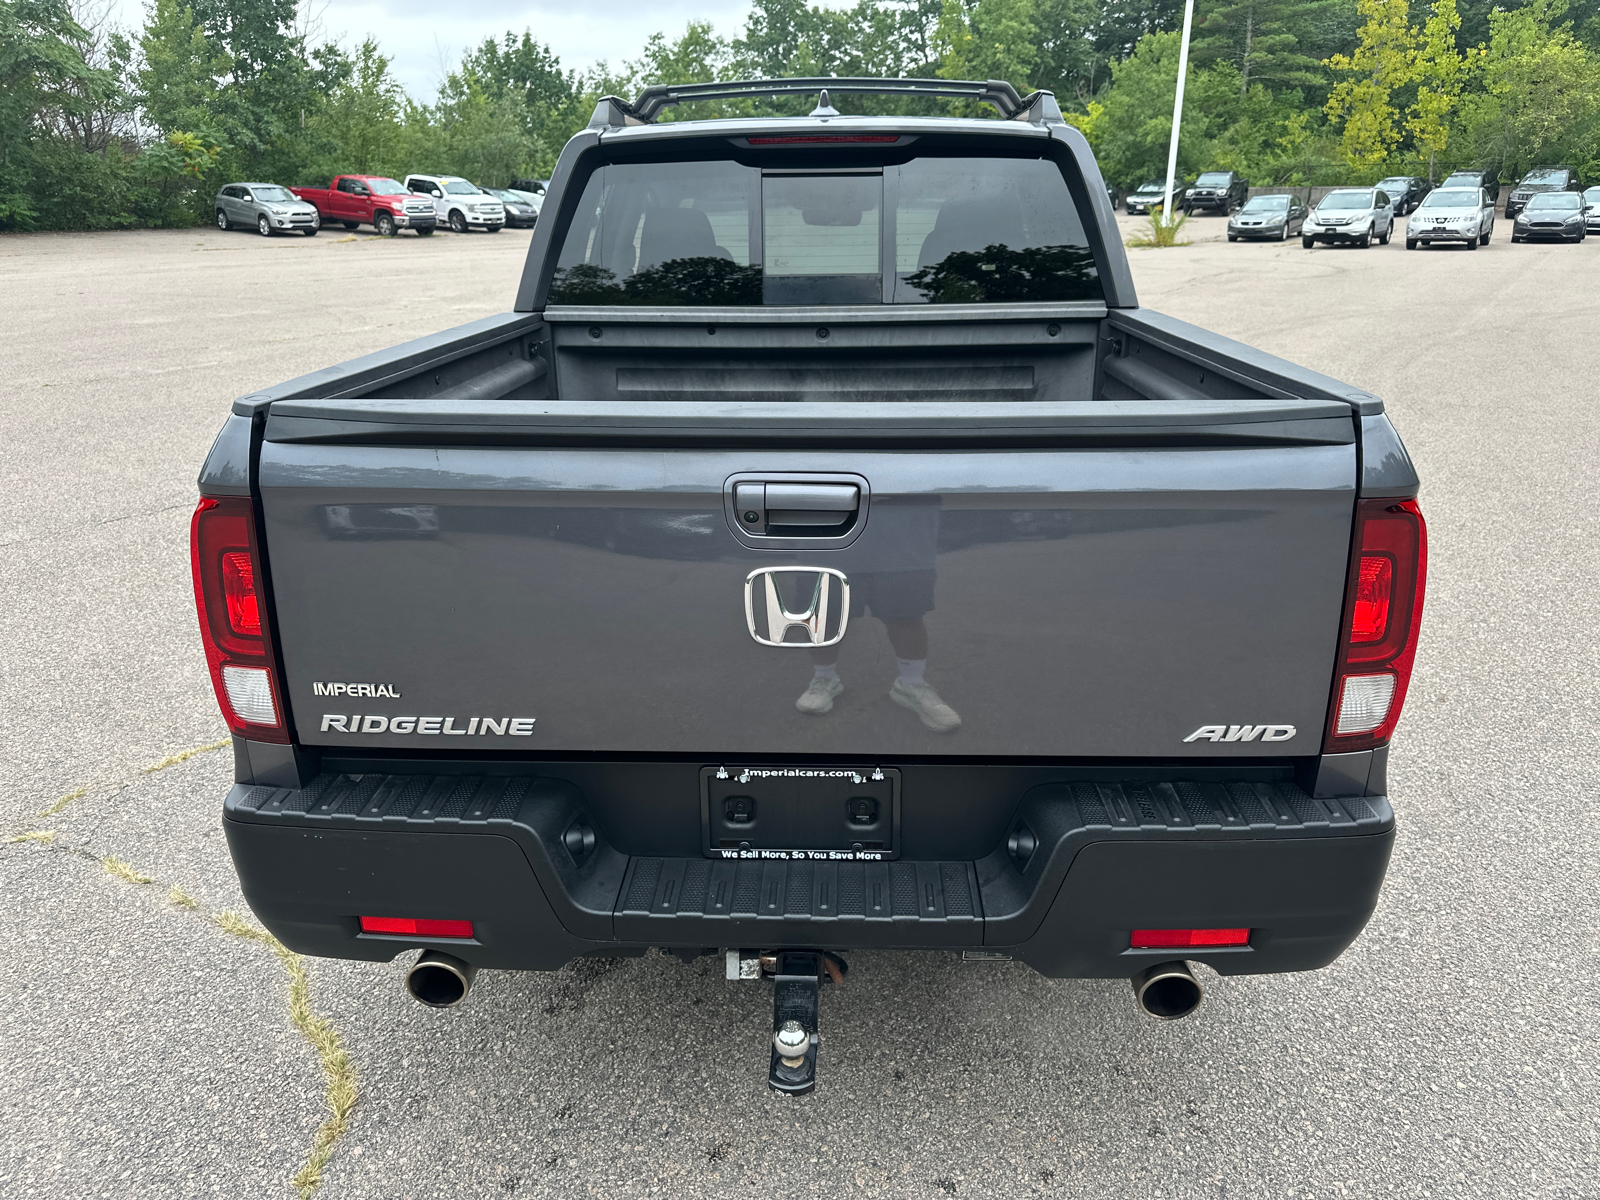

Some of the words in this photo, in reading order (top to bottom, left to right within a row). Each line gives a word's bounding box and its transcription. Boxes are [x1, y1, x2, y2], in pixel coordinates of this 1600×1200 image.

[312, 681, 402, 698] IMPERIAL
[320, 714, 536, 736] RIDGELINE
[1182, 724, 1297, 743] AWD
[743, 768, 856, 778] Imperialcars.com
[721, 850, 739, 859] We
[740, 850, 760, 859] Sell
[761, 850, 790, 860] More,
[792, 851, 805, 859] So
[807, 851, 827, 860] You
[828, 851, 853, 860] Save
[856, 851, 882, 860] More
